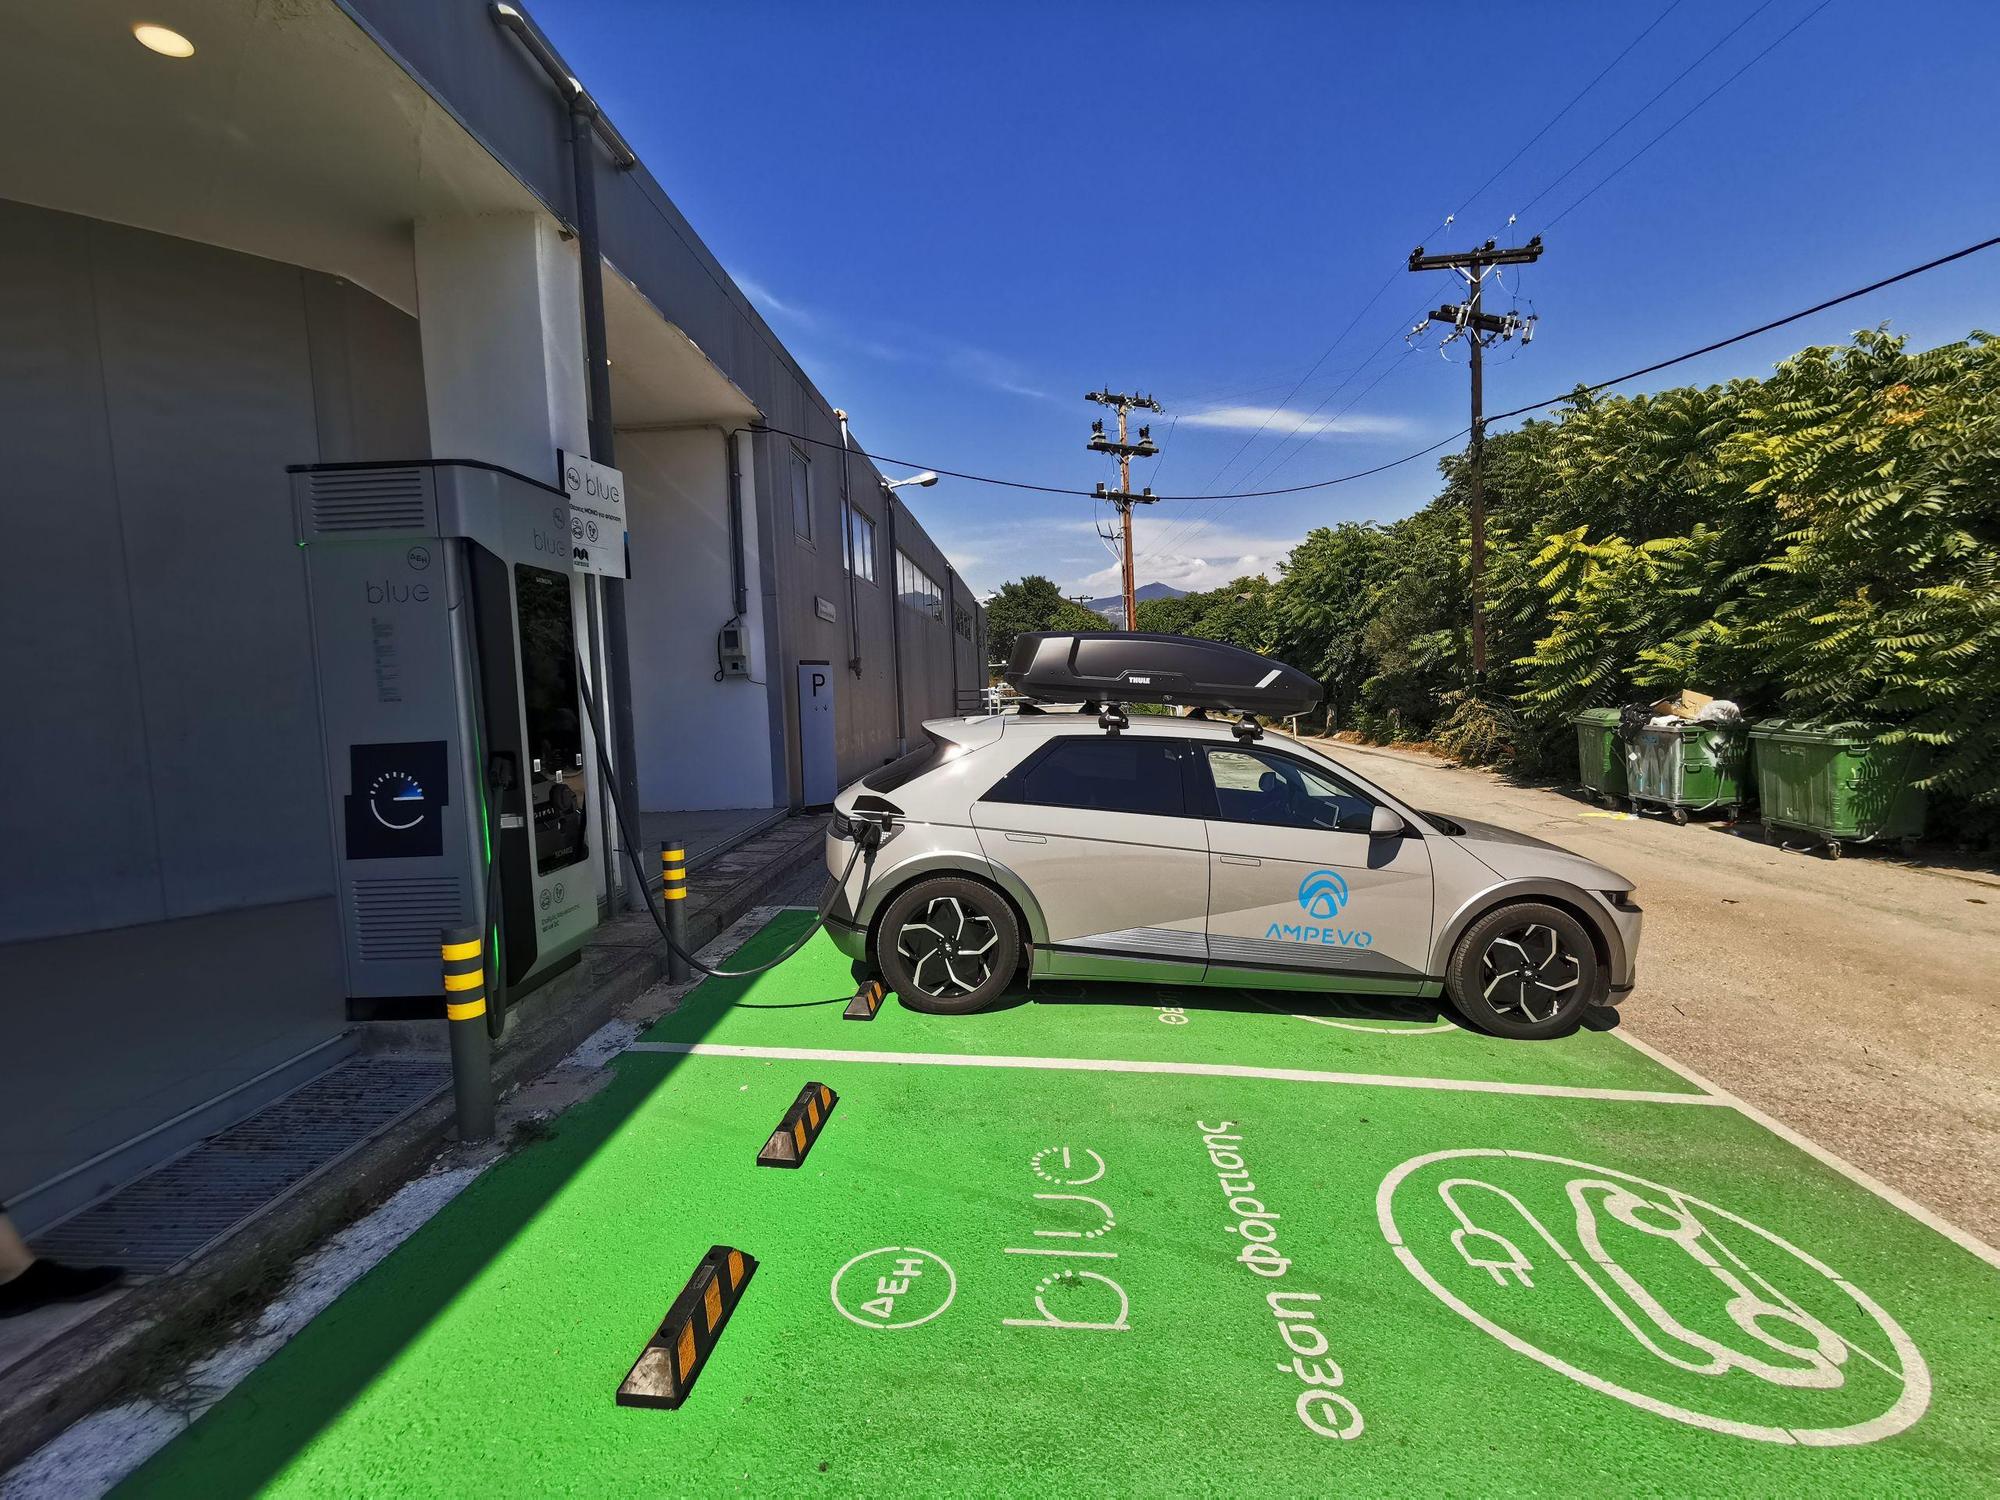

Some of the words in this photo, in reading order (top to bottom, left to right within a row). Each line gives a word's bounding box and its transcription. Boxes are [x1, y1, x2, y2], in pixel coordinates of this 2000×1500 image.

[586, 472, 620, 503] blue
[533, 527, 567, 557] blue
[366, 579, 430, 604] blue
[812, 673, 825, 698] P
[1128, 676, 1151, 685] THULE
[1265, 922, 1374, 948] AMPEVO
[1197, 1119, 1292, 1278] φόρτισης
[1003, 1146, 1131, 1332] blue
[860, 1259, 924, 1318] ΔΕΗ
[1266, 1291, 1365, 1440] Θέση
